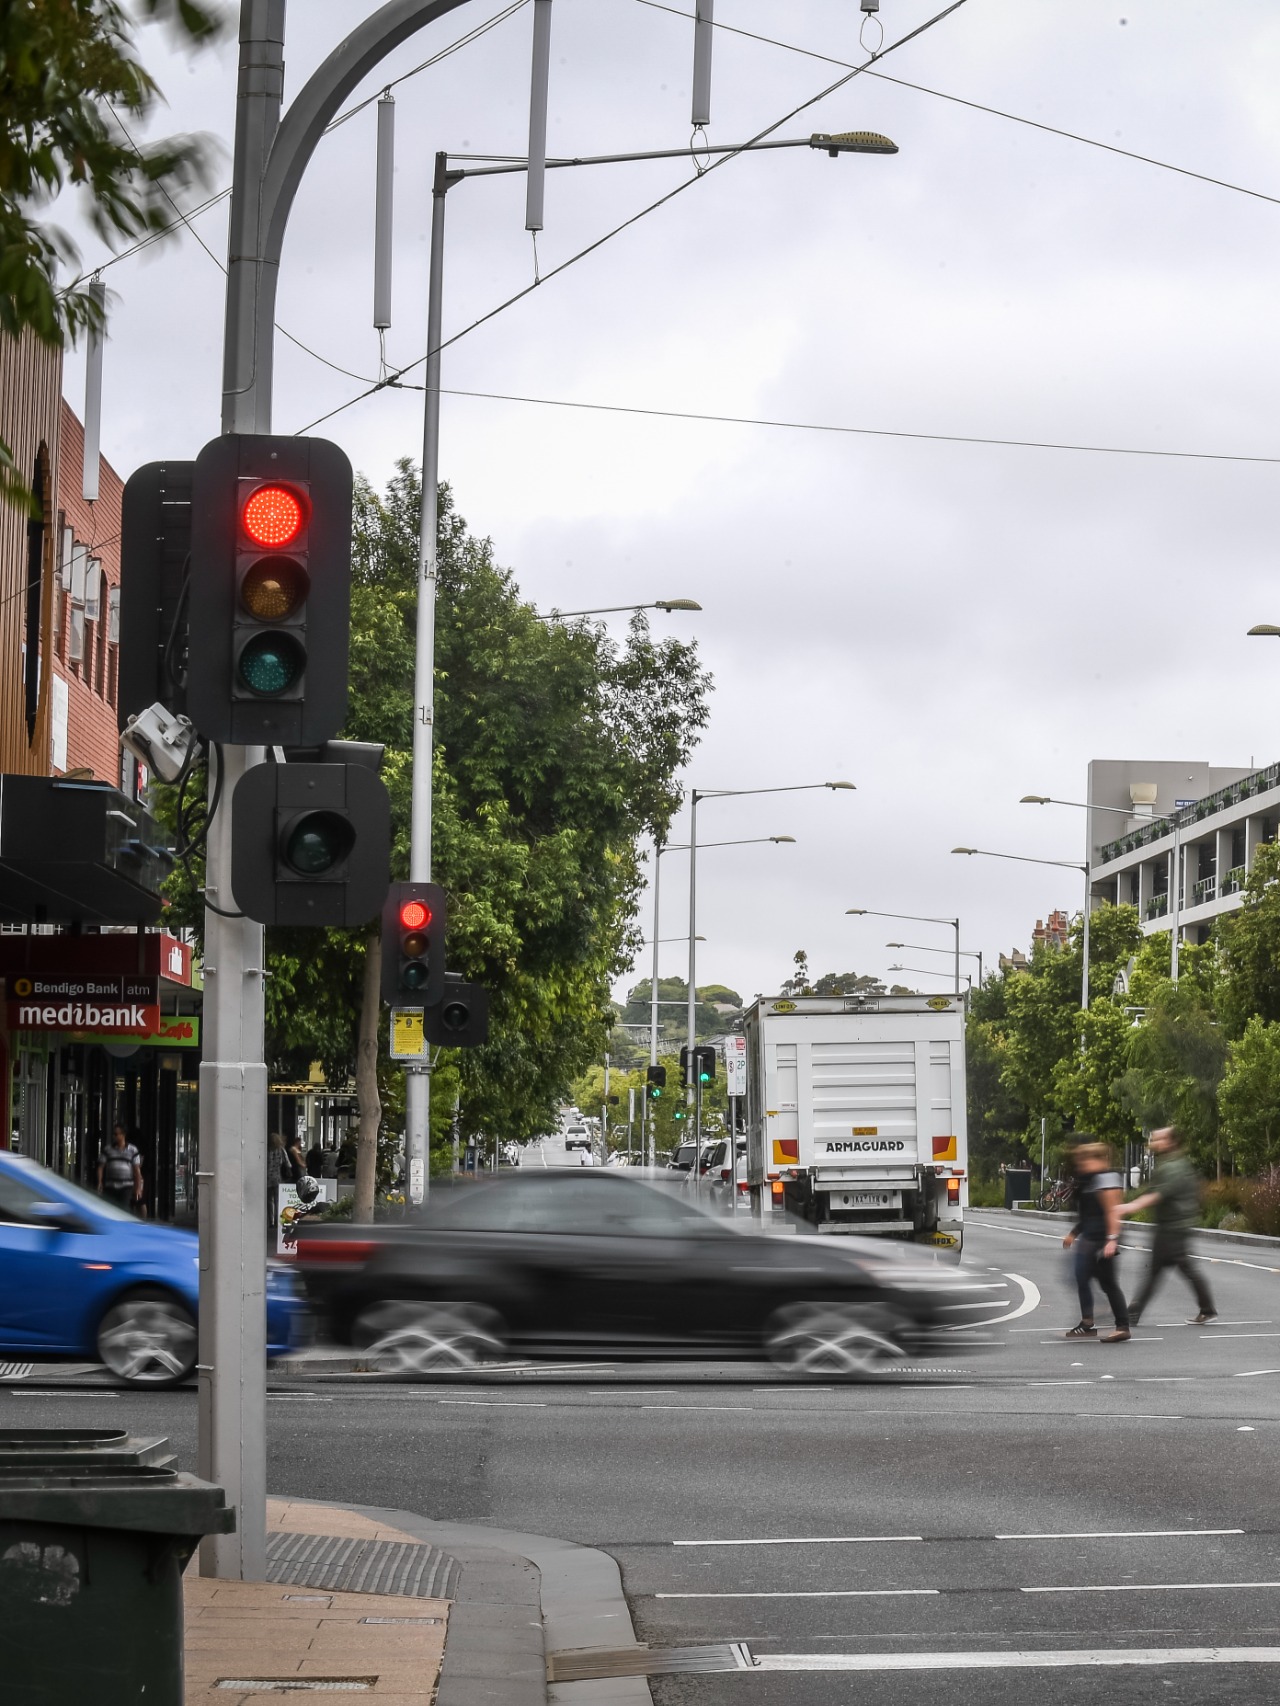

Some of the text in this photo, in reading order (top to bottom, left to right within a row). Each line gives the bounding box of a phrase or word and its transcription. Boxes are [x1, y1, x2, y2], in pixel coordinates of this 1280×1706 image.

[34, 982, 150, 996] Bendigo Bank atm
[19, 1003, 146, 1027] medibank
[826, 1141, 904, 1152] ARMAGUARD
